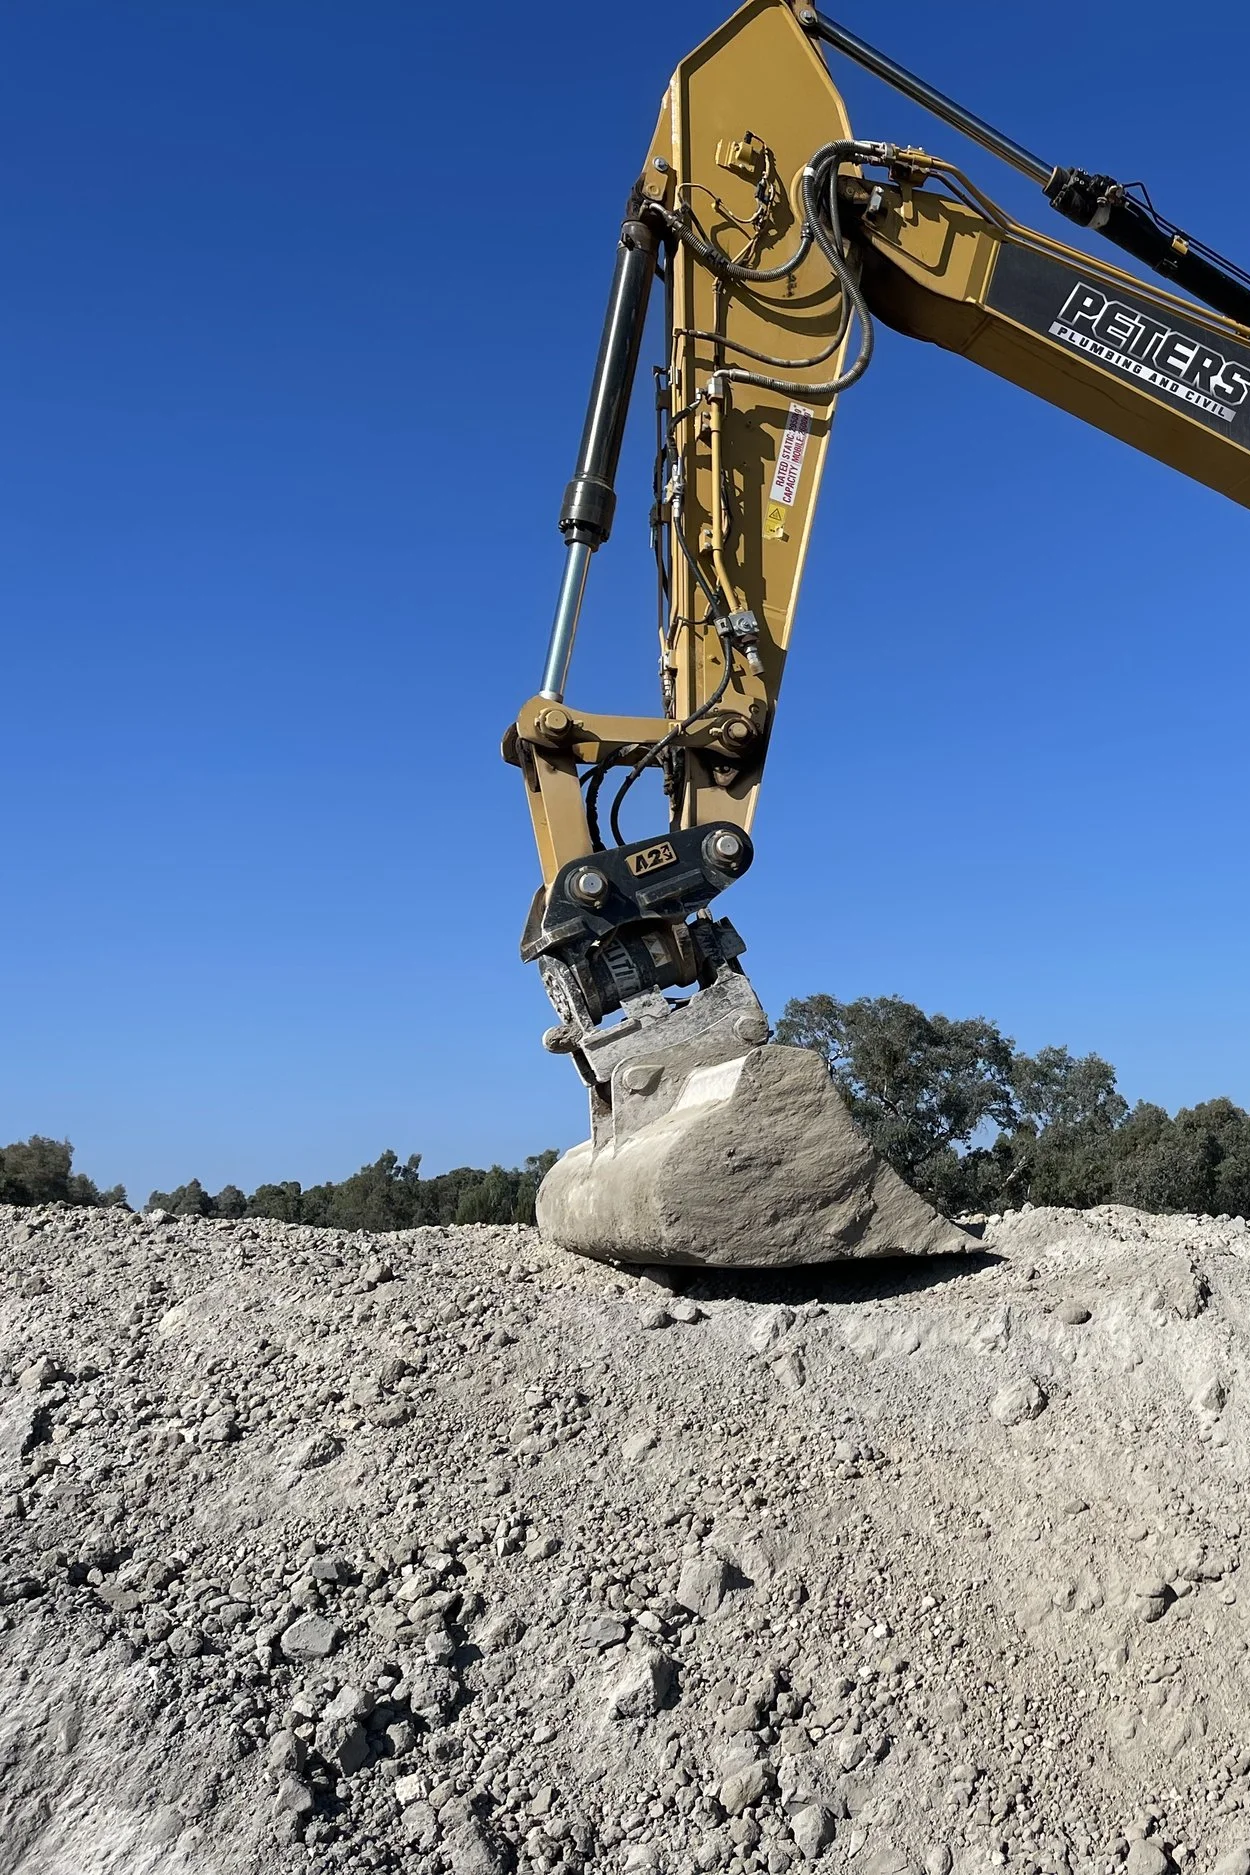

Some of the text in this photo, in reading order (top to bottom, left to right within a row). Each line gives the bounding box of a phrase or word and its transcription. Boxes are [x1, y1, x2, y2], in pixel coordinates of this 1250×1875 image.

[1056, 326, 1227, 418] PLUMBING AND CIVIL
[775, 461, 789, 487] RATED
[782, 465, 799, 503] CAPACITY
